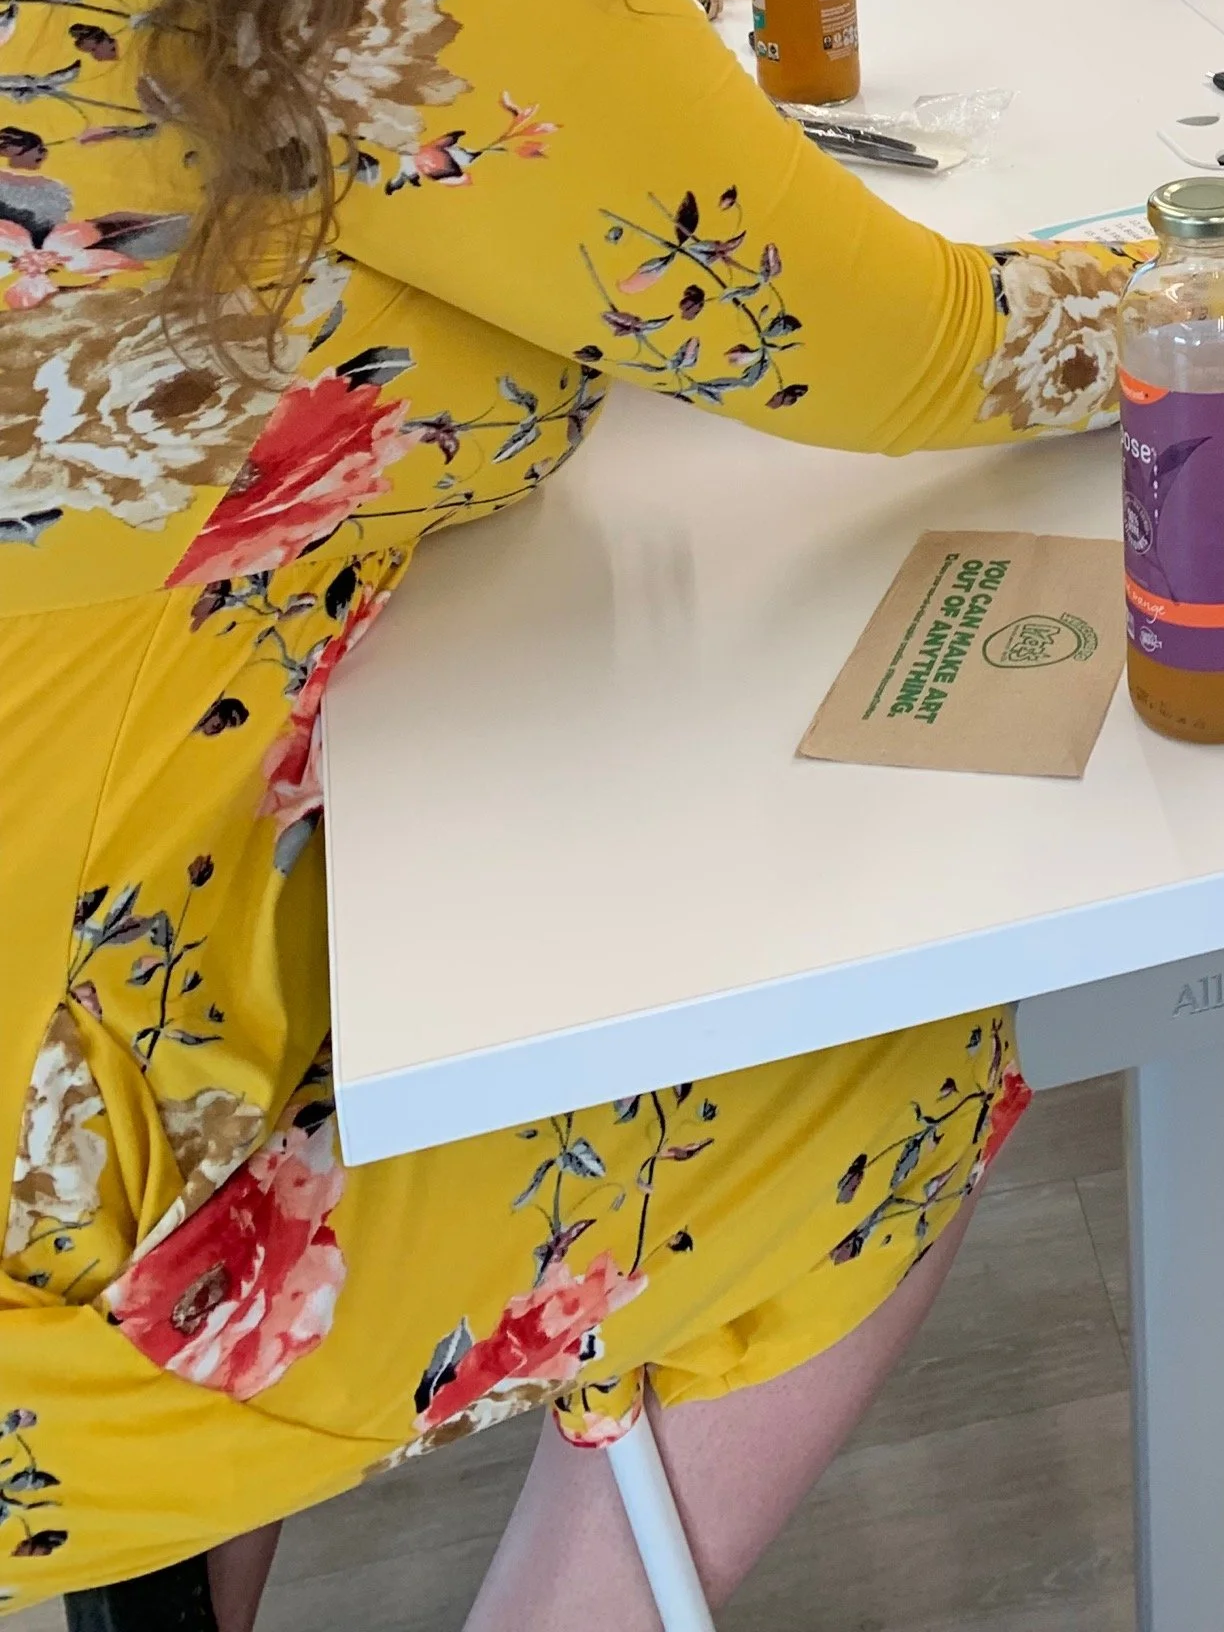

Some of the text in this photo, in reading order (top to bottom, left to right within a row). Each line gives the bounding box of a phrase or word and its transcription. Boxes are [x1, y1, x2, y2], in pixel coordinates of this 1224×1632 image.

[979, 559, 1011, 592] YOU
[959, 593, 993, 629] CAN
[887, 559, 983, 718] OUT OF ANYTHING.
[933, 631, 975, 684] MAKE
[914, 687, 948, 725] ART
